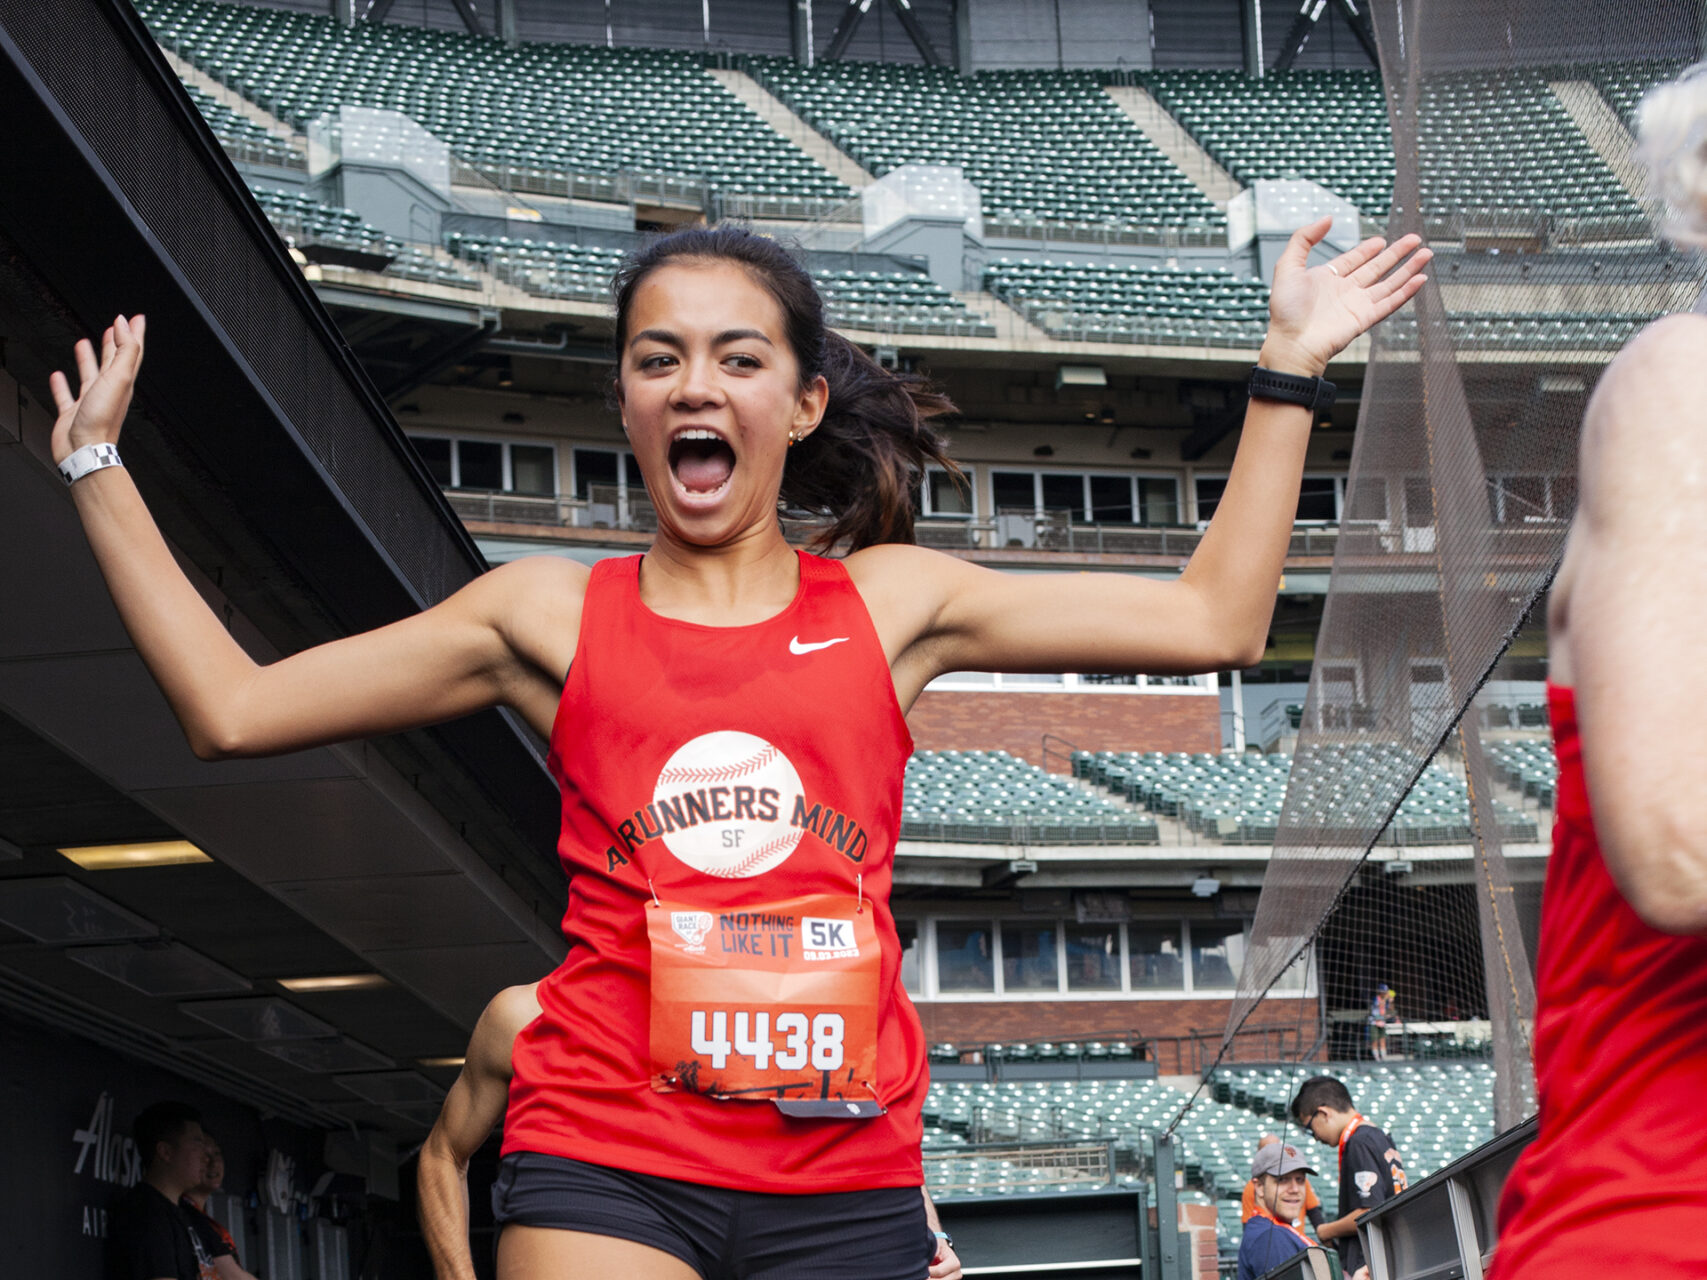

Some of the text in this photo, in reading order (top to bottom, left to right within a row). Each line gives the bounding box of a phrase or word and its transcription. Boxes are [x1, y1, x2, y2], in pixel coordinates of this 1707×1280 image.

[605, 786, 868, 872] A RUNNERS MIND
[721, 829, 745, 848] SF
[720, 912, 794, 932] NOTHING
[811, 921, 846, 947] 5K
[721, 933, 763, 956] LIKE
[771, 934, 794, 958] IT
[690, 1010, 846, 1071] 4438
[72, 1090, 142, 1189] Alask
